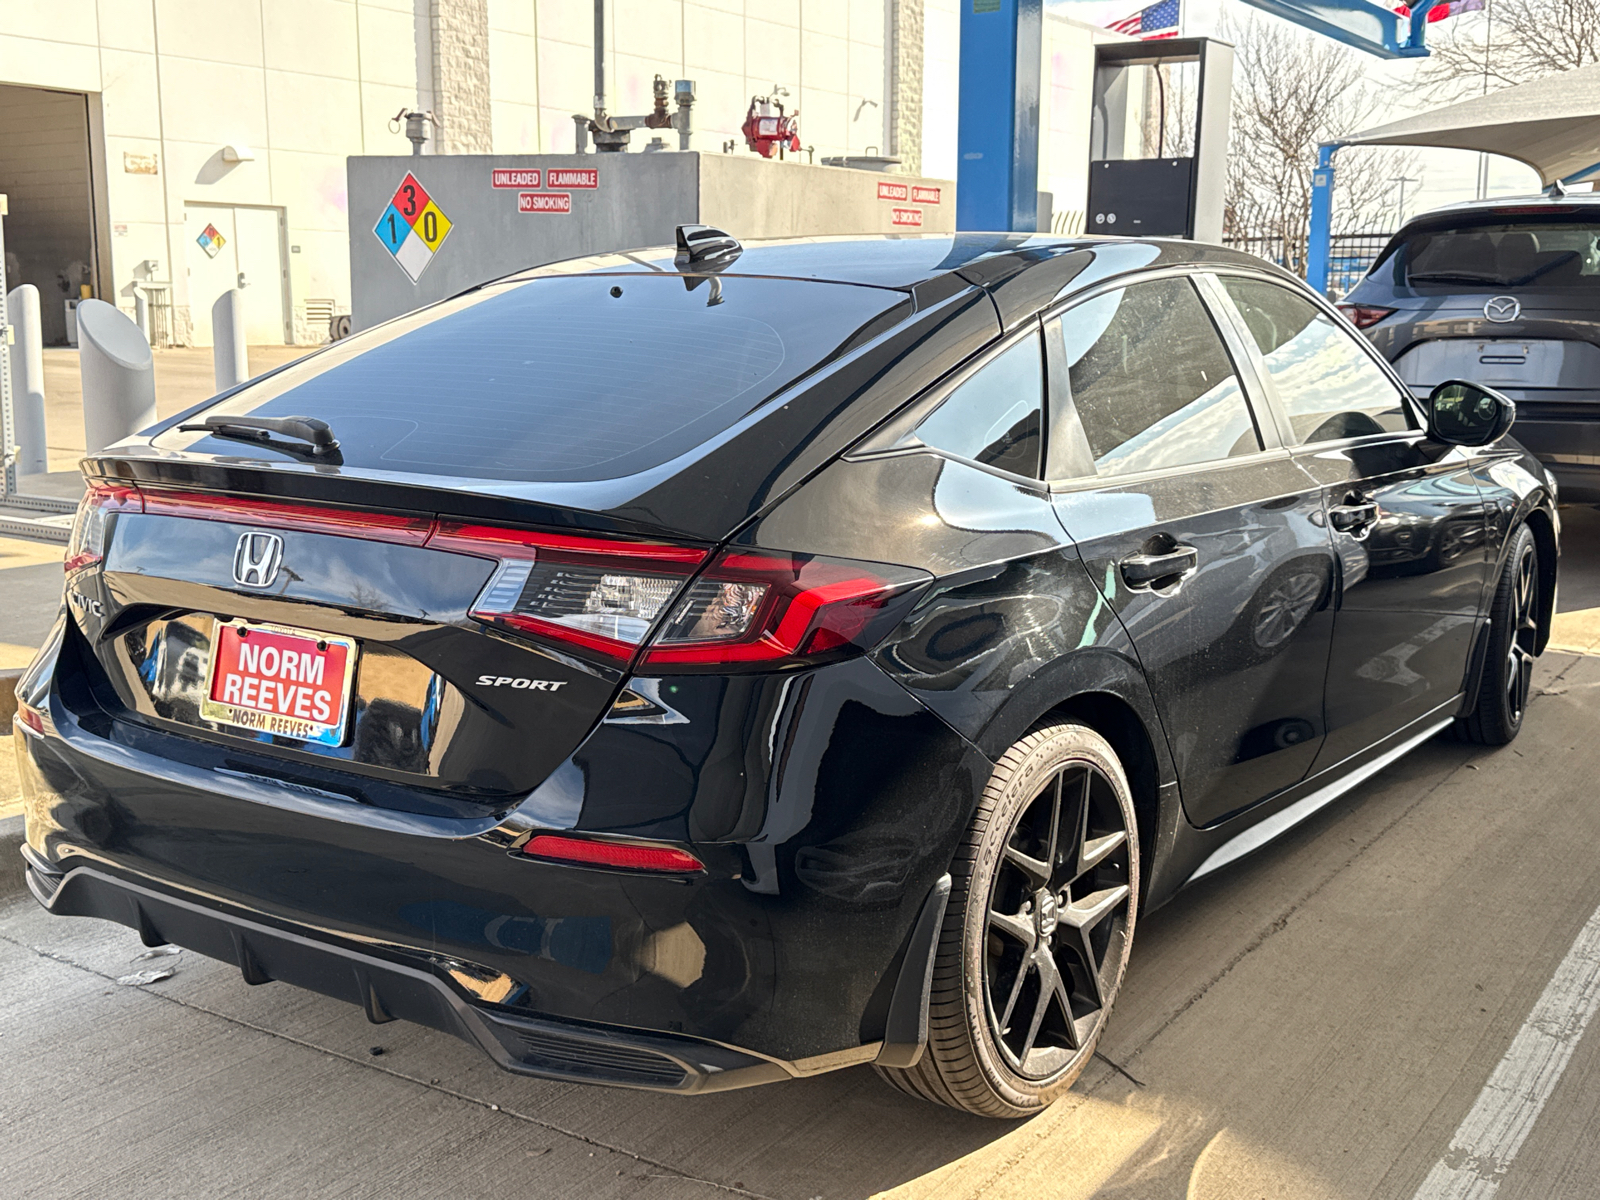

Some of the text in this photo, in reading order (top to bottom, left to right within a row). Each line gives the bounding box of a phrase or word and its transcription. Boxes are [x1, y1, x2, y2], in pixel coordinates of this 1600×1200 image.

[494, 172, 539, 185] UNLEADED
[549, 172, 596, 186] FLAMMABLE
[403, 184, 416, 216] 3
[520, 196, 569, 210] NO SMOKING
[879, 185, 906, 198] UNLEADED
[387, 211, 438, 244] 1 0
[238, 642, 325, 686] NORM
[475, 675, 568, 692] SPORT
[223, 673, 332, 721] REEVES
[232, 708, 309, 738] NORM REEVES
